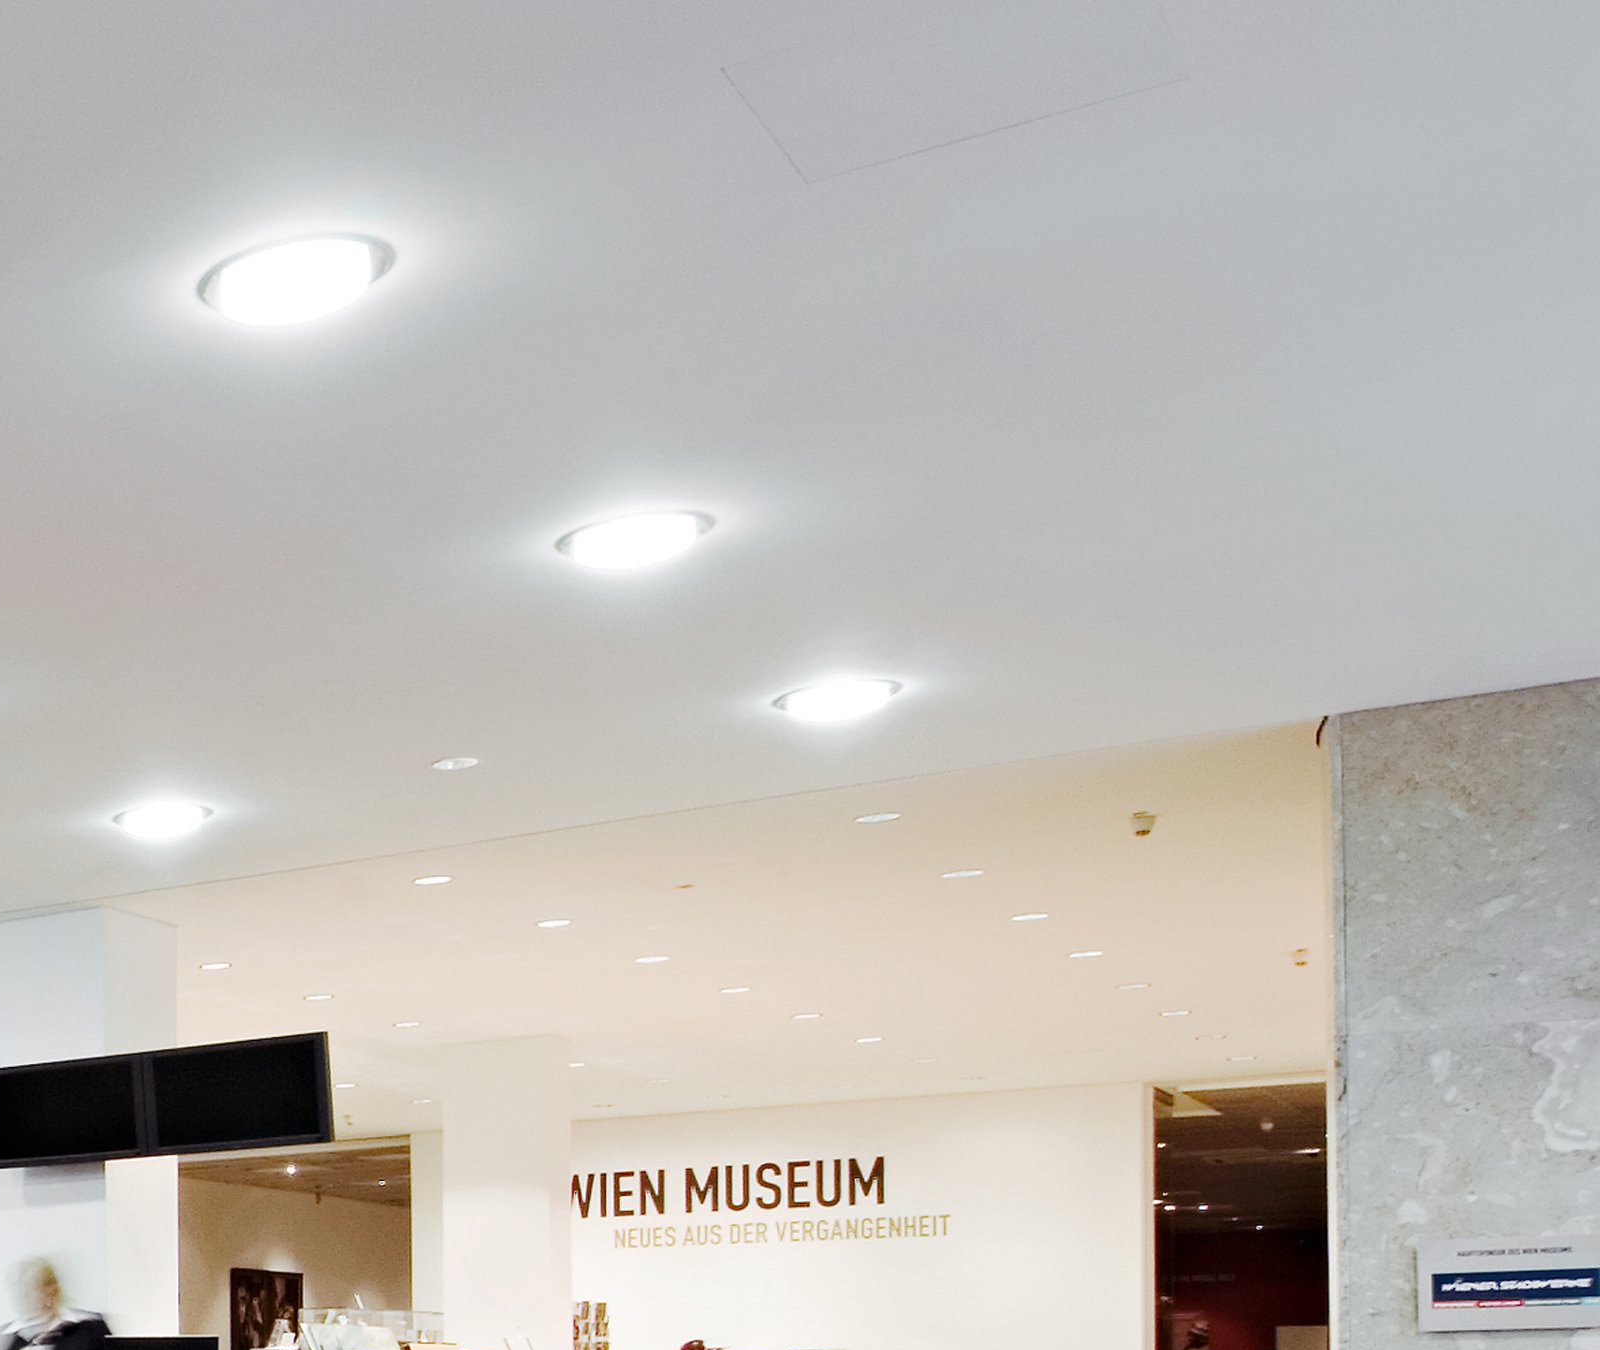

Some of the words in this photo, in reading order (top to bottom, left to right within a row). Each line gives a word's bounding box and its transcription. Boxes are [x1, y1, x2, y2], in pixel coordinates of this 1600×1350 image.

[571, 1168, 666, 1219] WIEN
[685, 1156, 886, 1214] MUSEUM
[614, 1226, 677, 1249] NEUES
[682, 1224, 723, 1247] AUS
[730, 1222, 768, 1244] DER
[776, 1214, 952, 1242] VERGANGENHEIT
